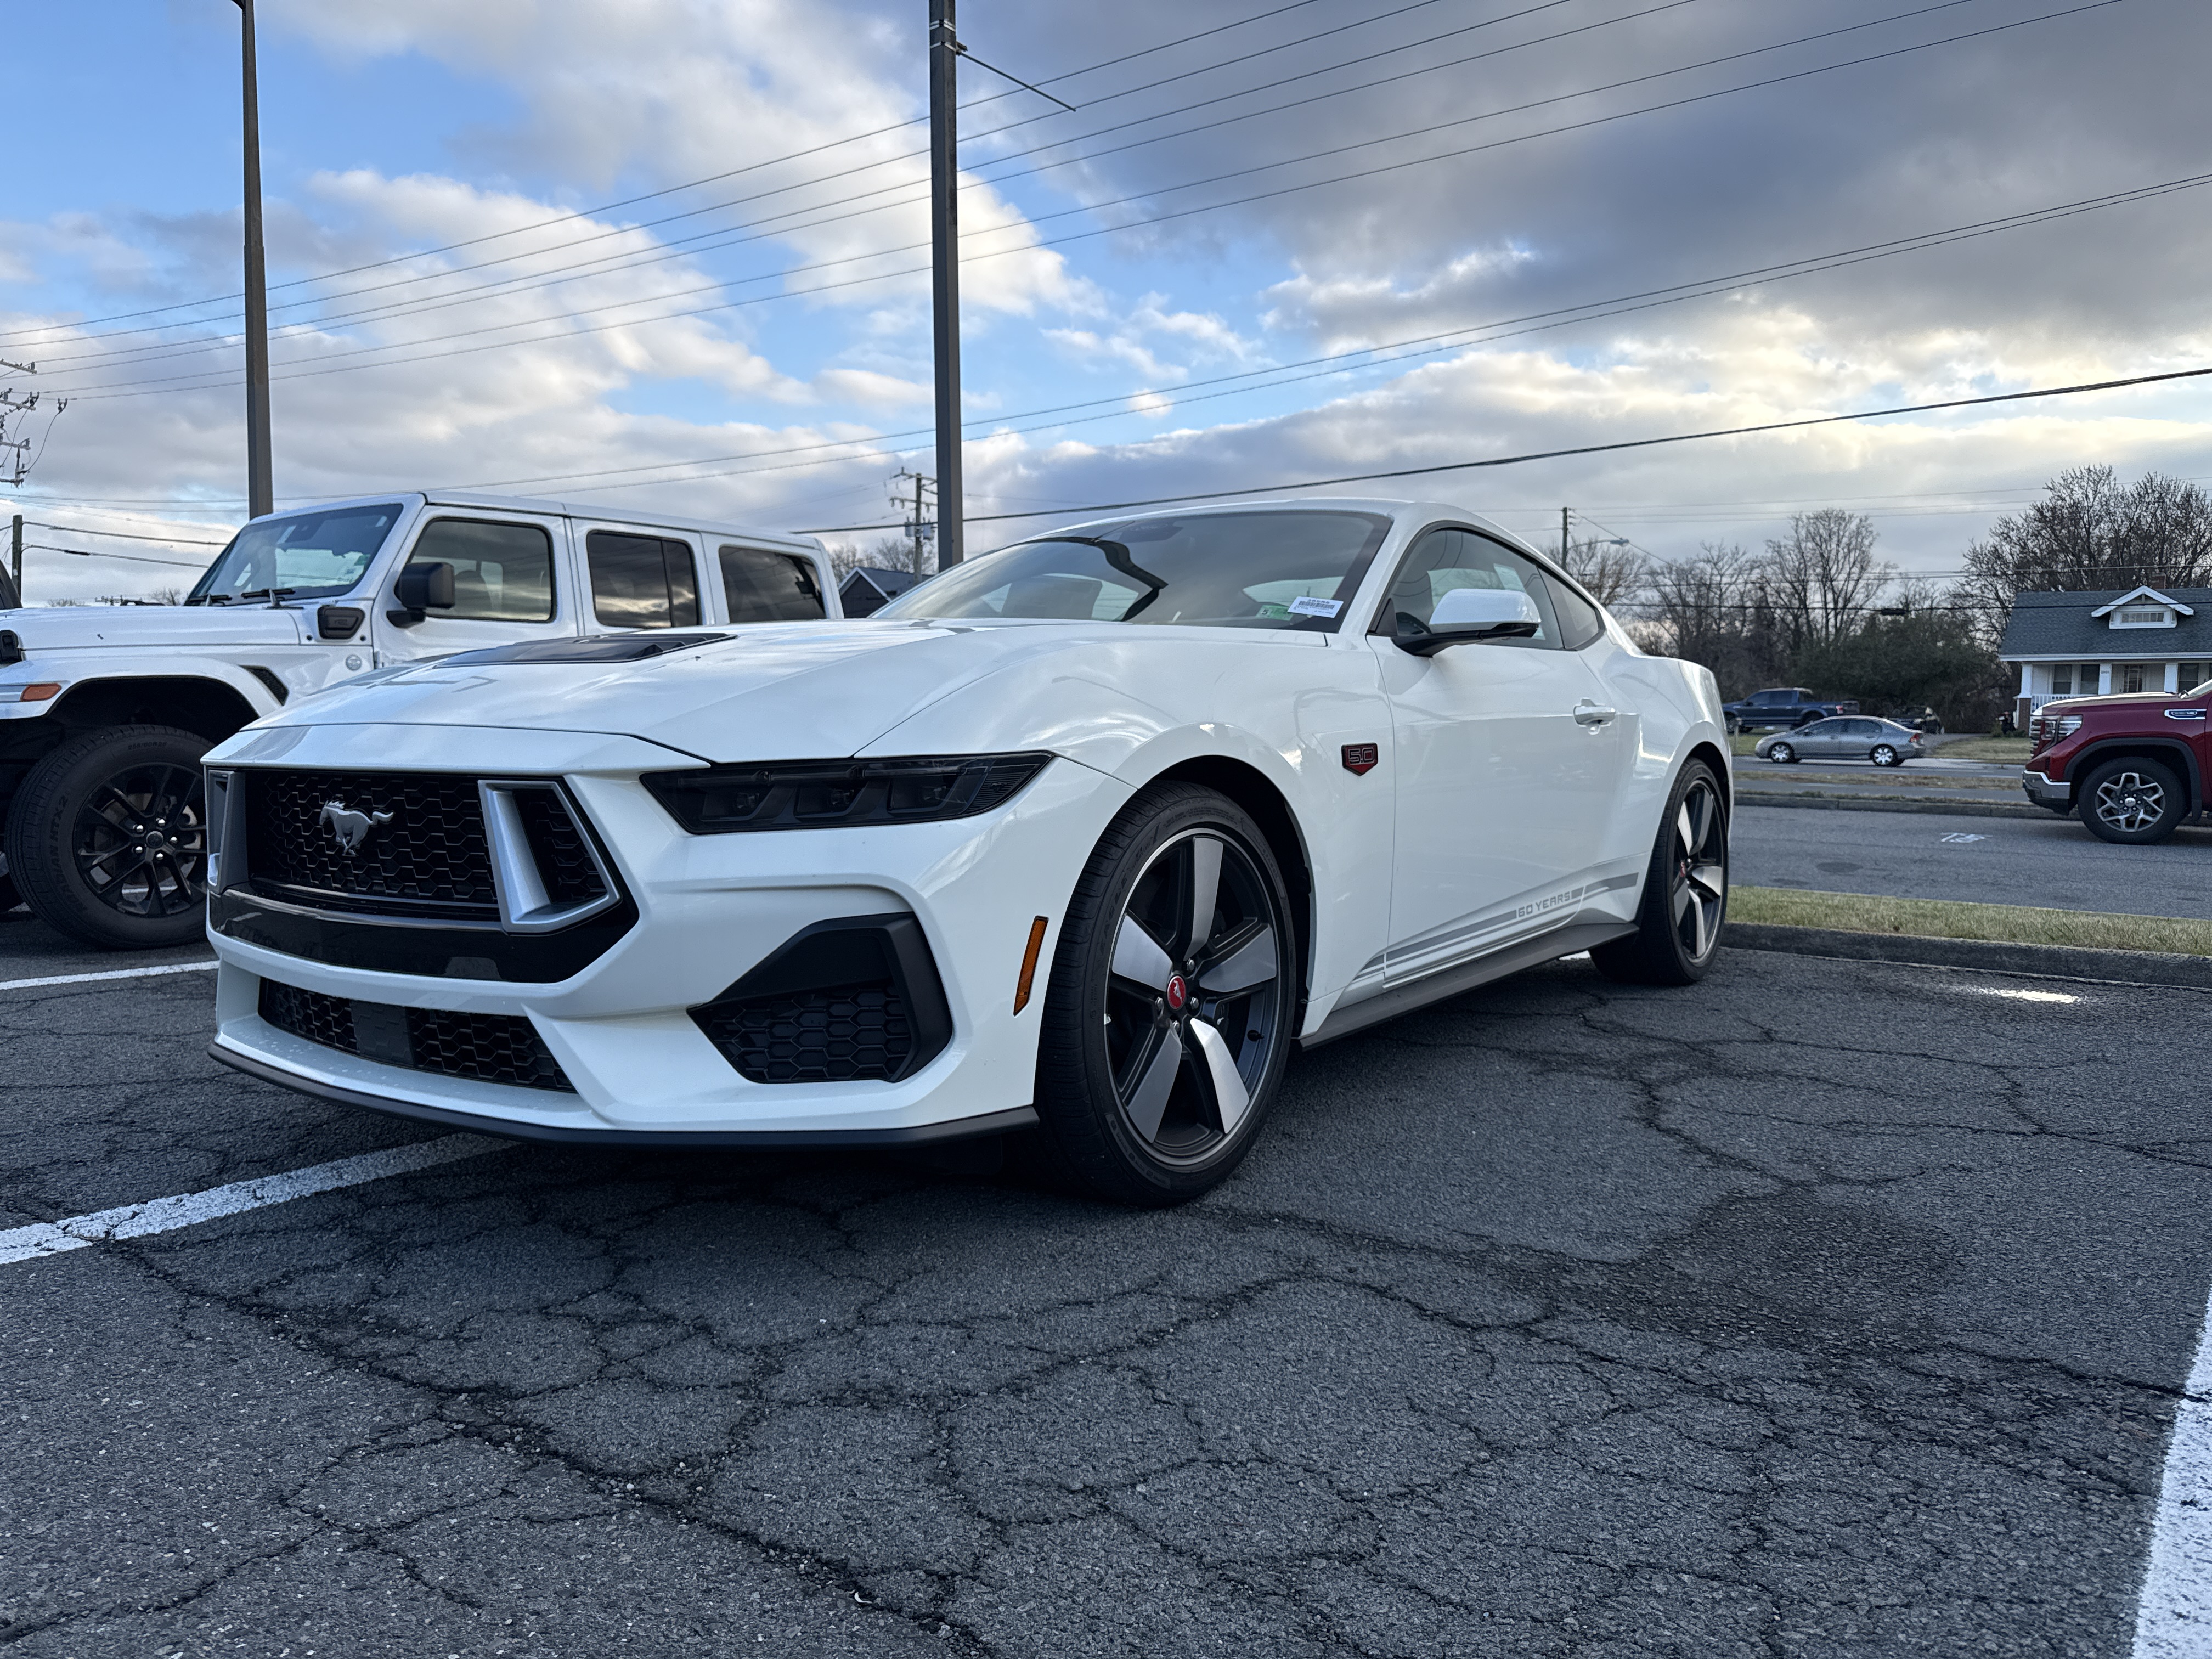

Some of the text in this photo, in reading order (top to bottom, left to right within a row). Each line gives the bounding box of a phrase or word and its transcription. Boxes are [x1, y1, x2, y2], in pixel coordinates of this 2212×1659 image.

[1348, 747, 1375, 765] 5.0
[1099, 873, 1128, 956] EAGLE
[1518, 891, 1570, 918] 60 YEARS
